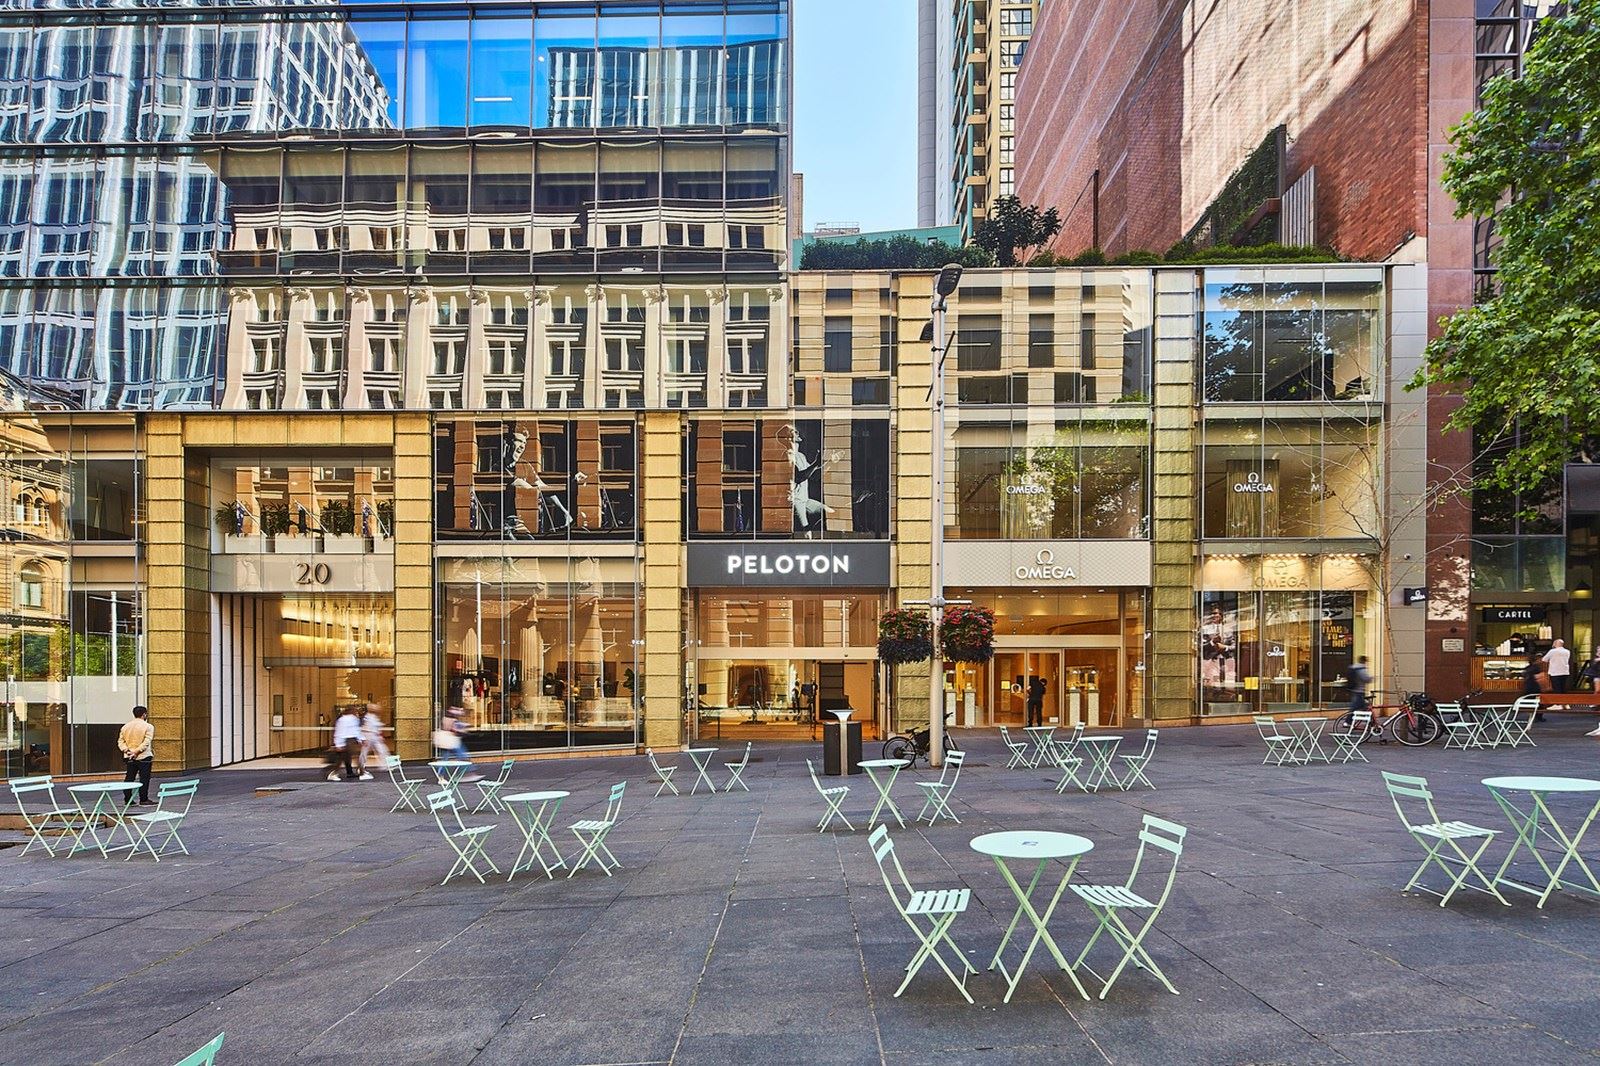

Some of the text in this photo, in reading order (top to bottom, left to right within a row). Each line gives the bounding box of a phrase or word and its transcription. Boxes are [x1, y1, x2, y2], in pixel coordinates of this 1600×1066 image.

[1006, 485, 1046, 494] OMEGA
[1234, 483, 1274, 493] OMEGA
[727, 555, 849, 574] PELOTON
[296, 562, 331, 585] 20
[1015, 566, 1076, 579] OMEGA
[1254, 576, 1309, 588] OMEGA
